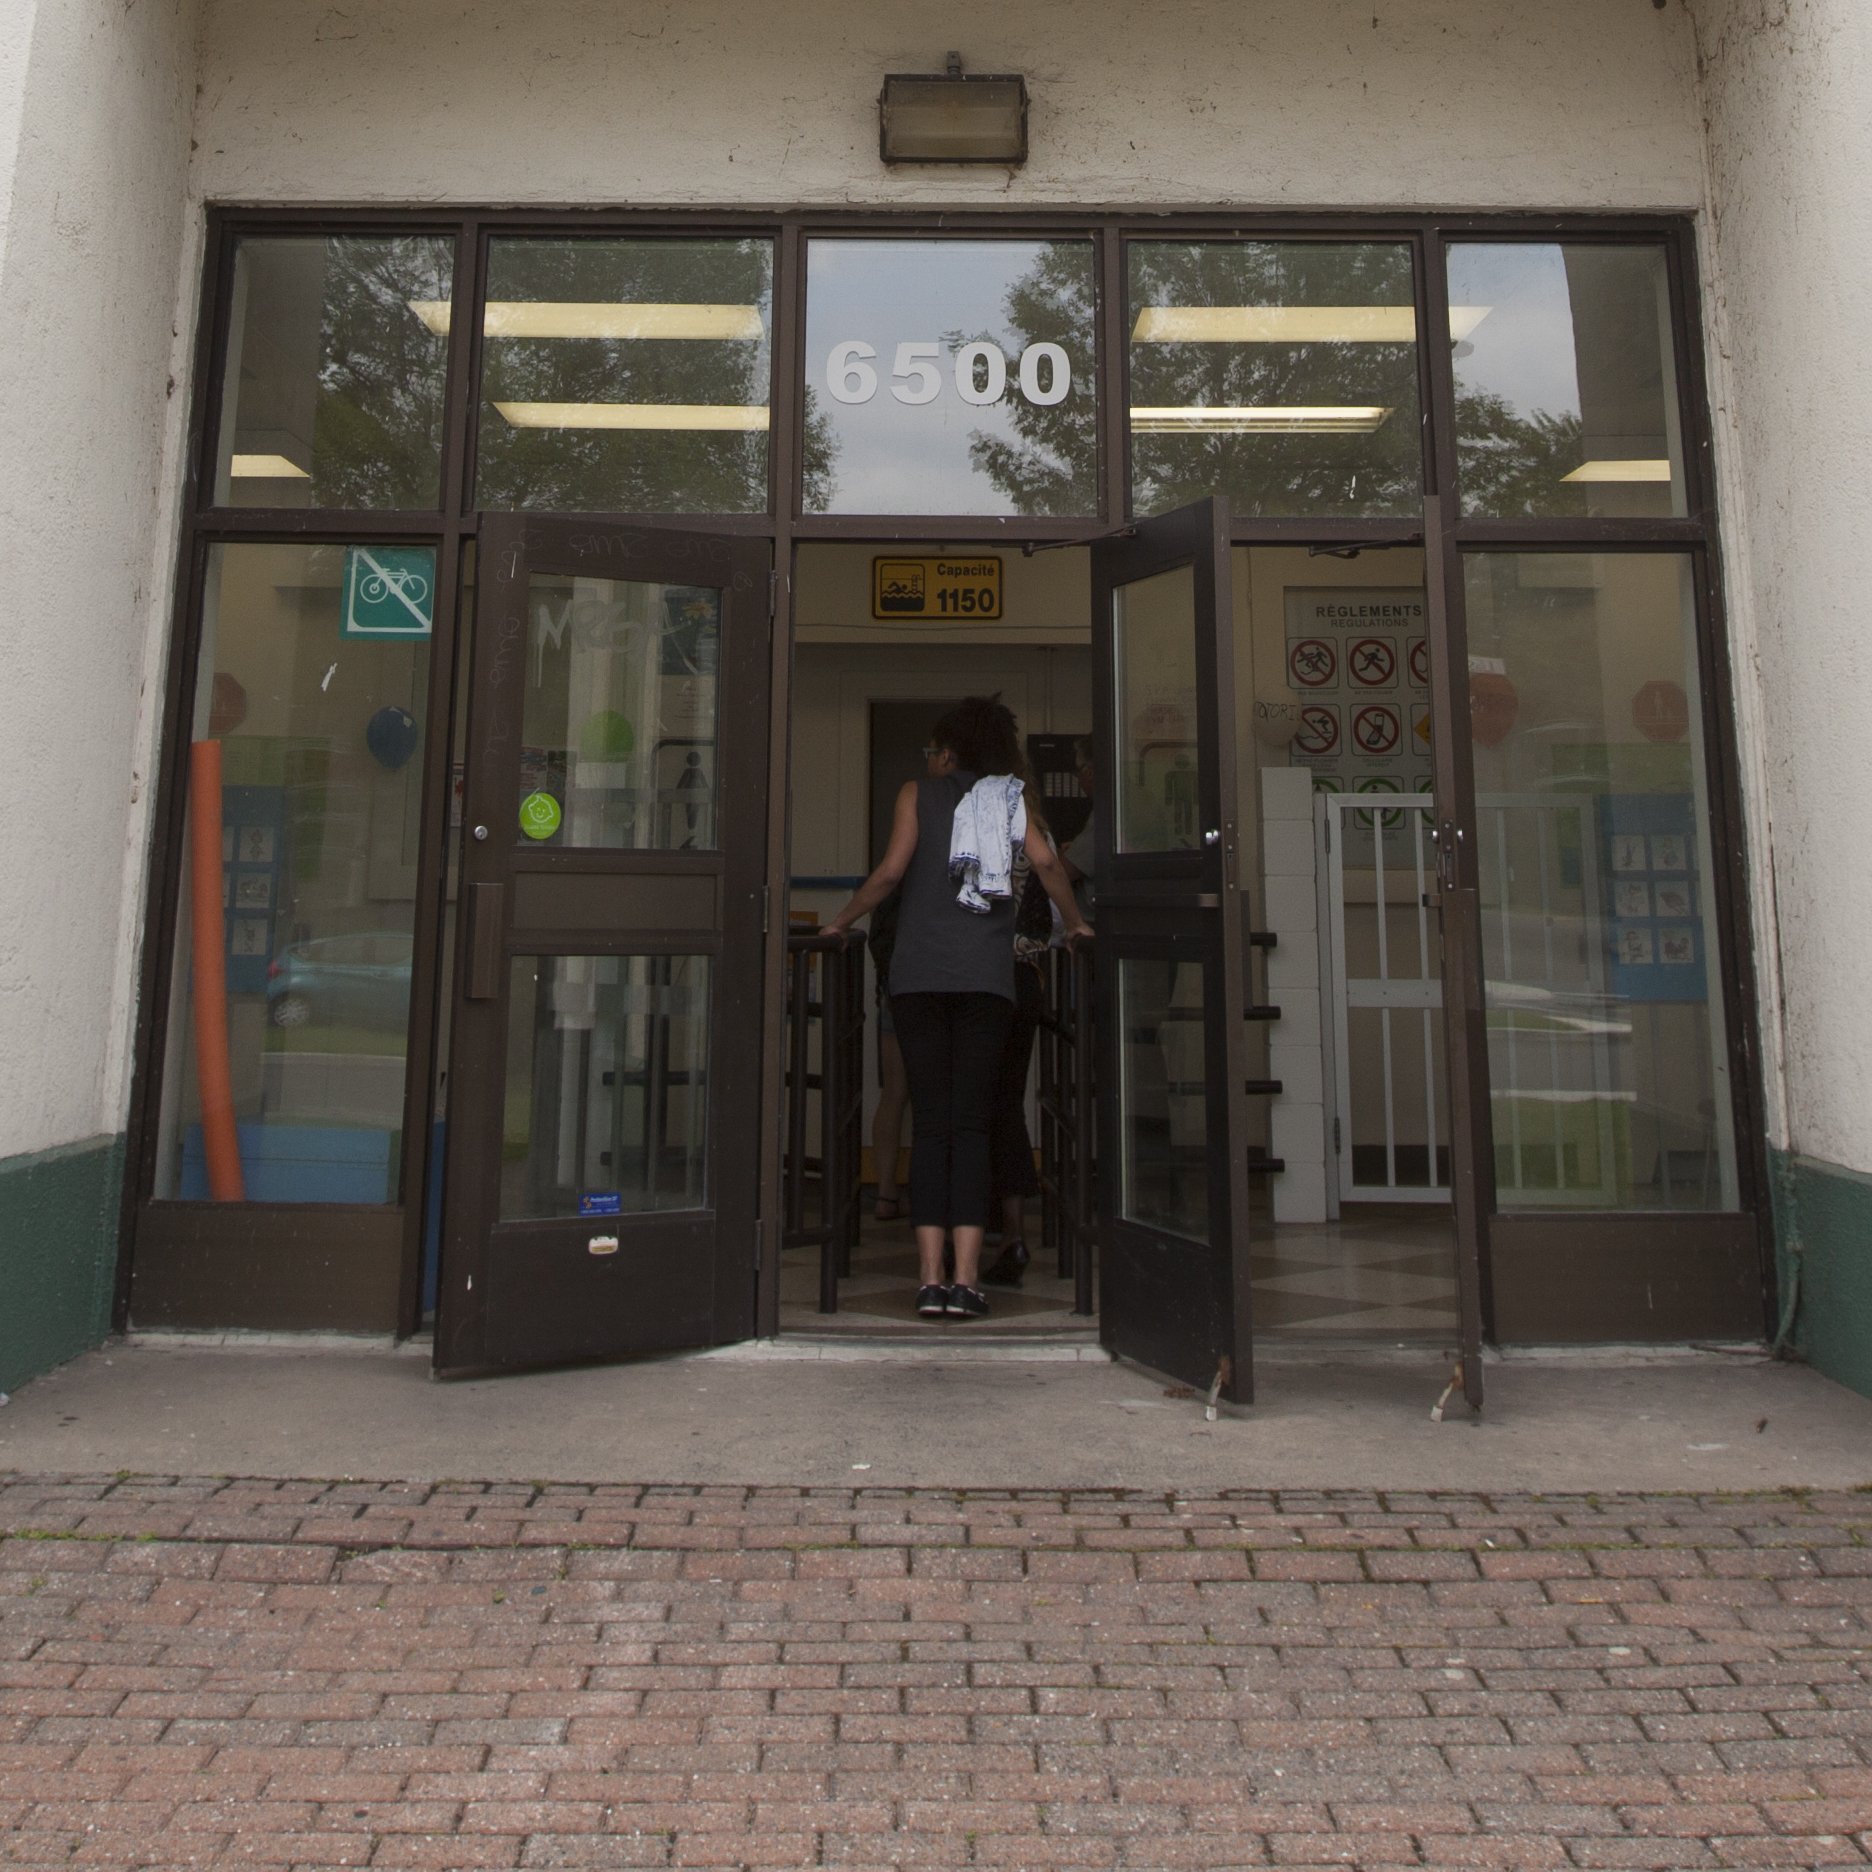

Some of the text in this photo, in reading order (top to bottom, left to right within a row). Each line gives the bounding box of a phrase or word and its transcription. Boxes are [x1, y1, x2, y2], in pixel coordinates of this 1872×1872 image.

[826, 340, 1071, 406] 6500
[936, 563, 995, 578] Capacité
[936, 588, 995, 612] 1150
[1315, 604, 1422, 618] RÈGLEMENTS
[1330, 618, 1408, 628] REGULATIONS
